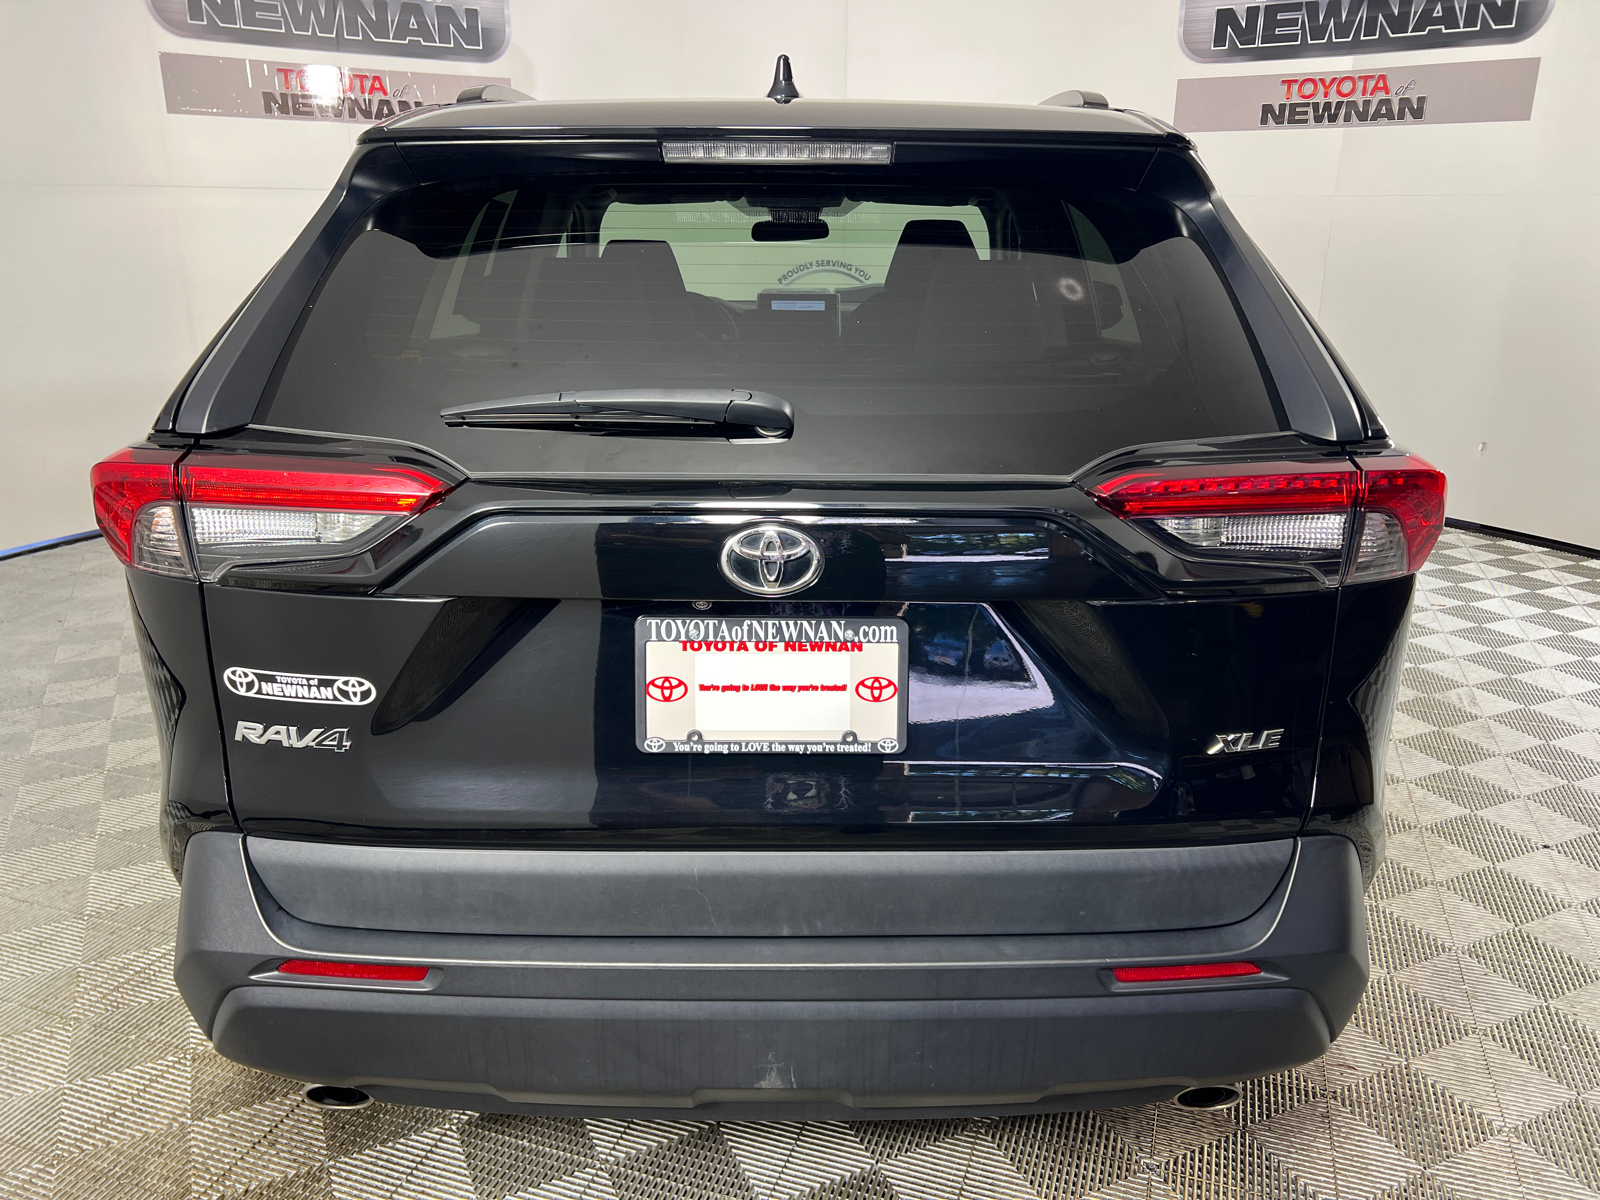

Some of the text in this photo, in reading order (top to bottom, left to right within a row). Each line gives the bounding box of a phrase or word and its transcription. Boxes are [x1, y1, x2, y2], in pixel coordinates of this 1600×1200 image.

[187, 0, 484, 50] NEWNAN
[1211, 0, 1520, 50] NEWNAN
[392, 84, 410, 99] of
[1280, 73, 1416, 100] TOYOTA of
[1259, 95, 1428, 126] NEWNAN
[777, 259, 872, 285] PROUDLY SERVING YOU
[679, 640, 863, 652] TOYOTA OF NEWNAN
[260, 681, 334, 700] NEWNAN
[275, 675, 319, 686] TOYOTA of
[234, 720, 353, 753] RAV4
[673, 741, 872, 754] You're going to LOVE the way you're treated!
[1207, 728, 1285, 755] XLE
